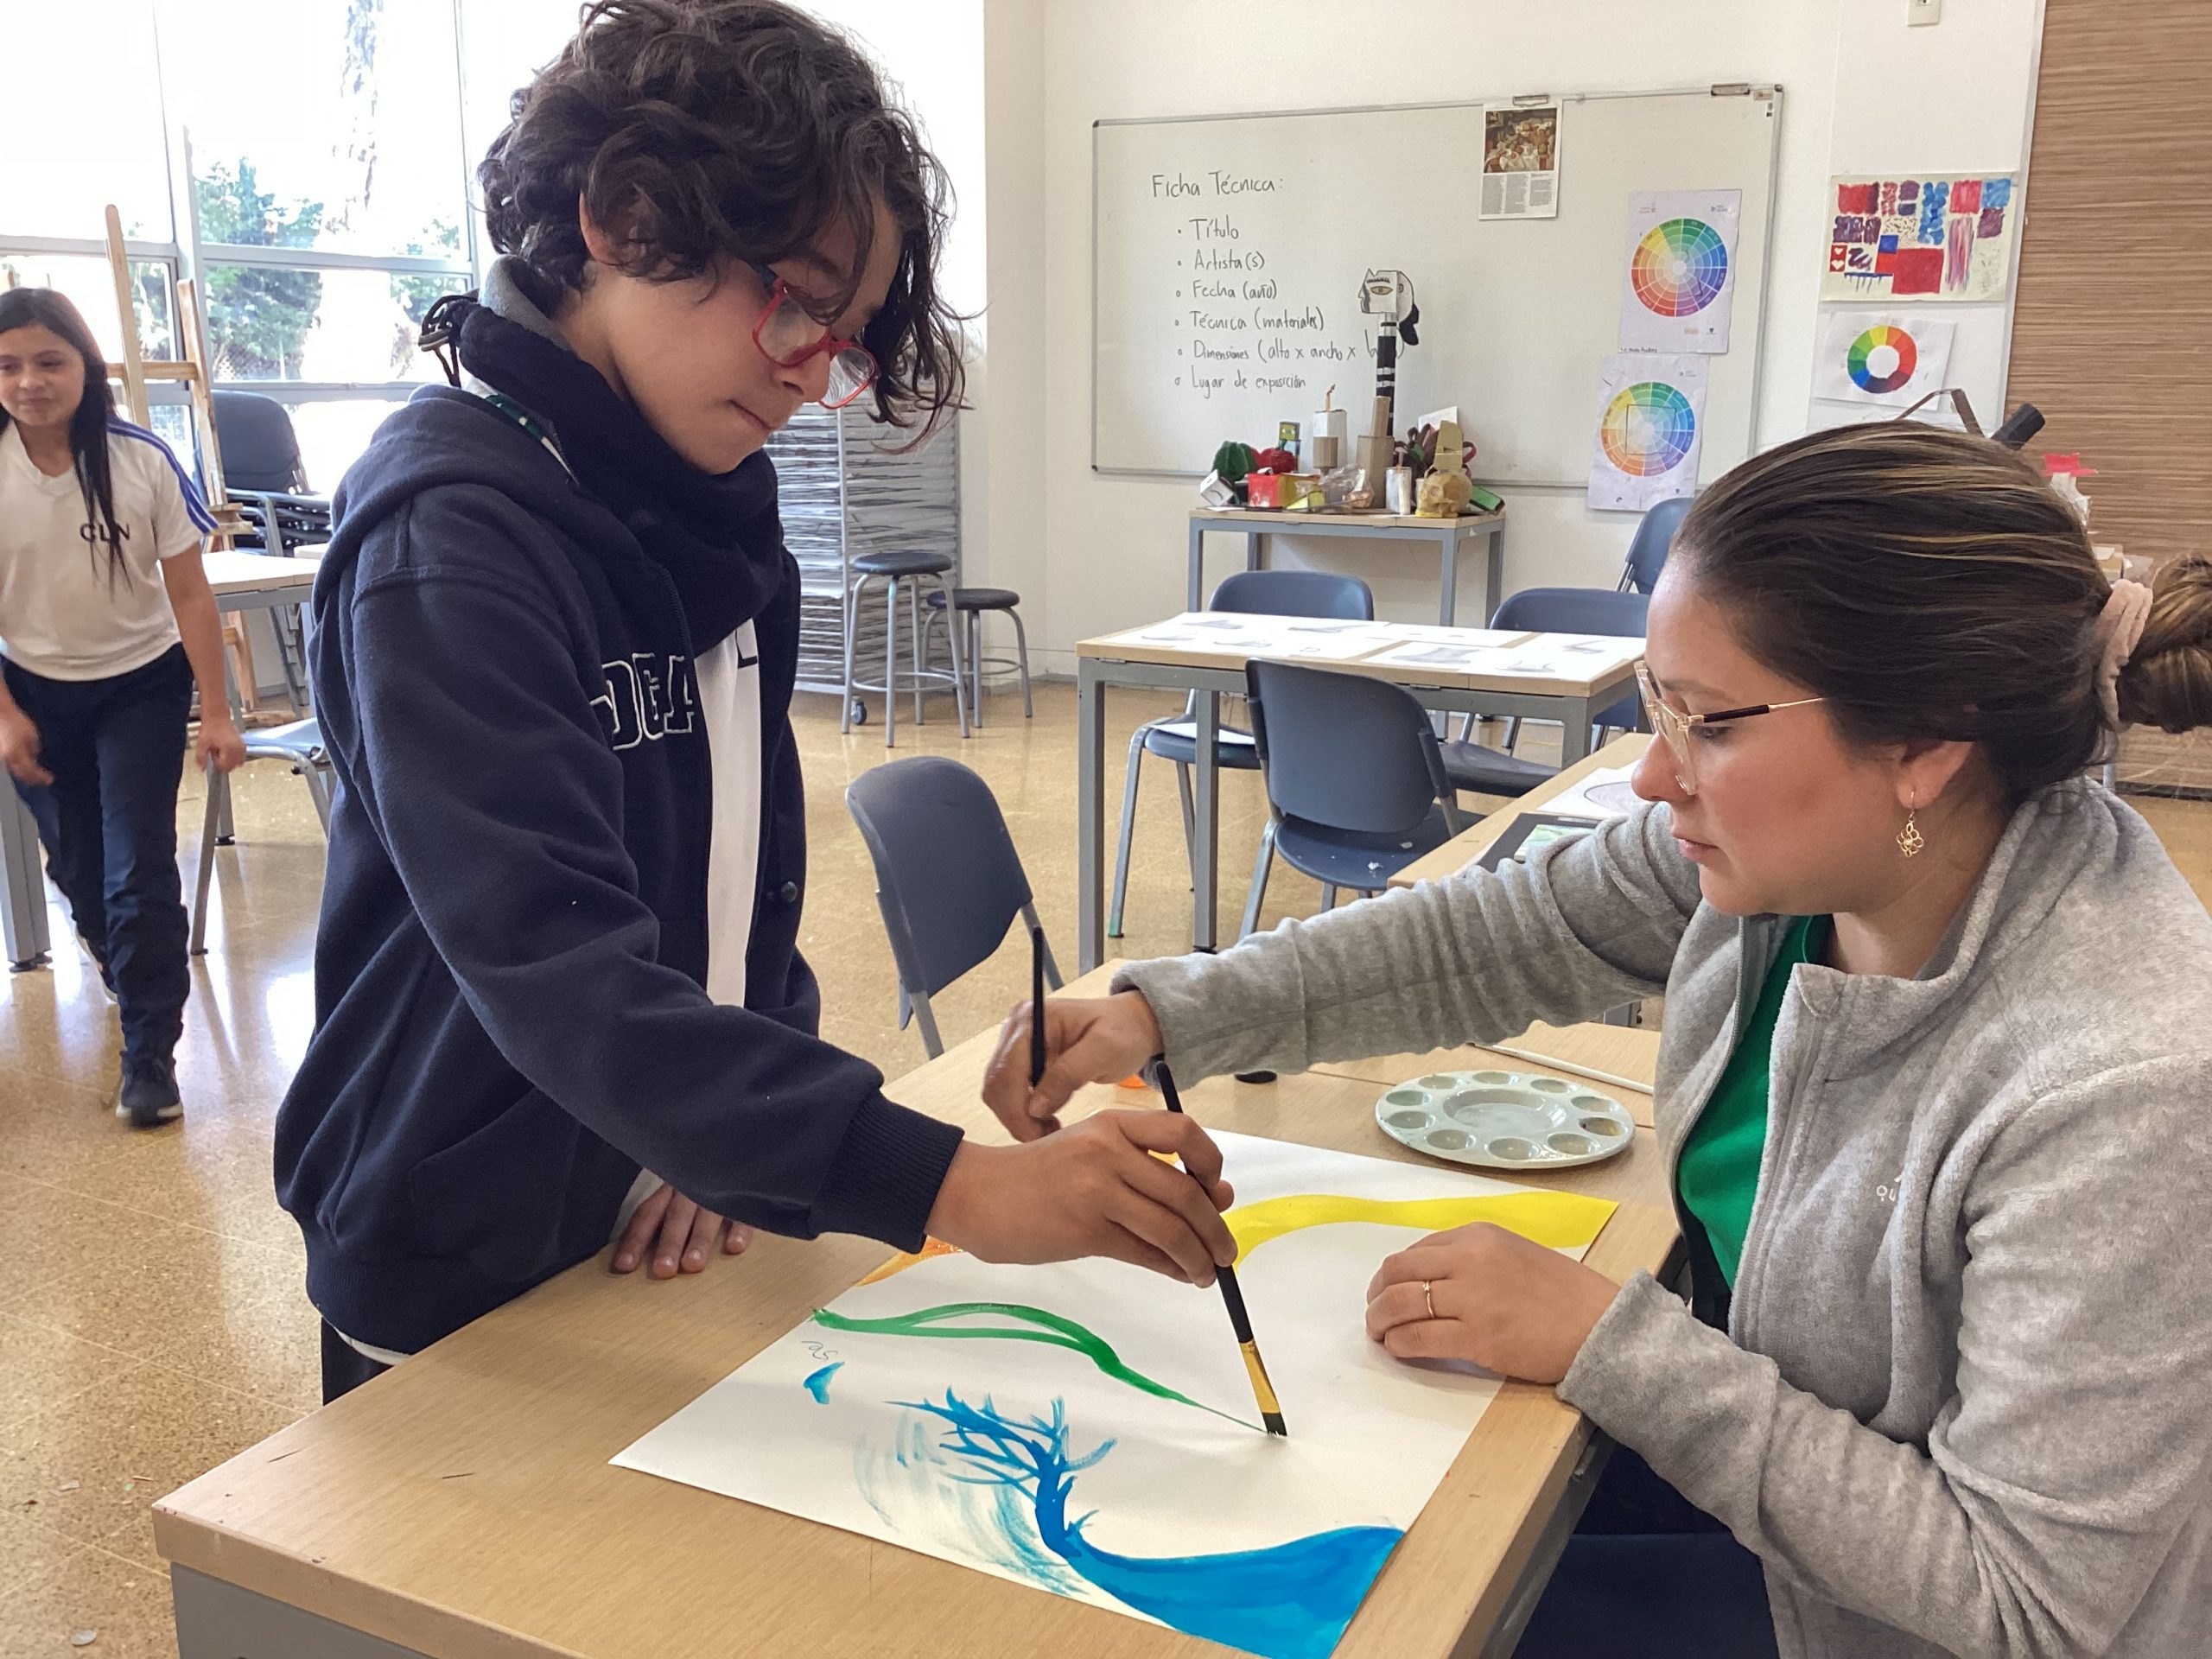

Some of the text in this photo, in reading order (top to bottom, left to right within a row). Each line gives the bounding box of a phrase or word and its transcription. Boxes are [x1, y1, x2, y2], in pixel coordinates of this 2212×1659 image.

[1152, 169, 1284, 198] Ficha Técnica:
[1188, 214, 1239, 240] Título
[1194, 248, 1266, 271] Artista(s)
[1192, 278, 1278, 301] Fecha (año)
[1189, 306, 1325, 332] Técnica (materiales)
[1193, 339, 1250, 361] Dimensiones
[1257, 336, 1290, 364] (alto
[1310, 340, 1344, 361] ancho
[1191, 365, 1306, 400] Lugar de exposición
